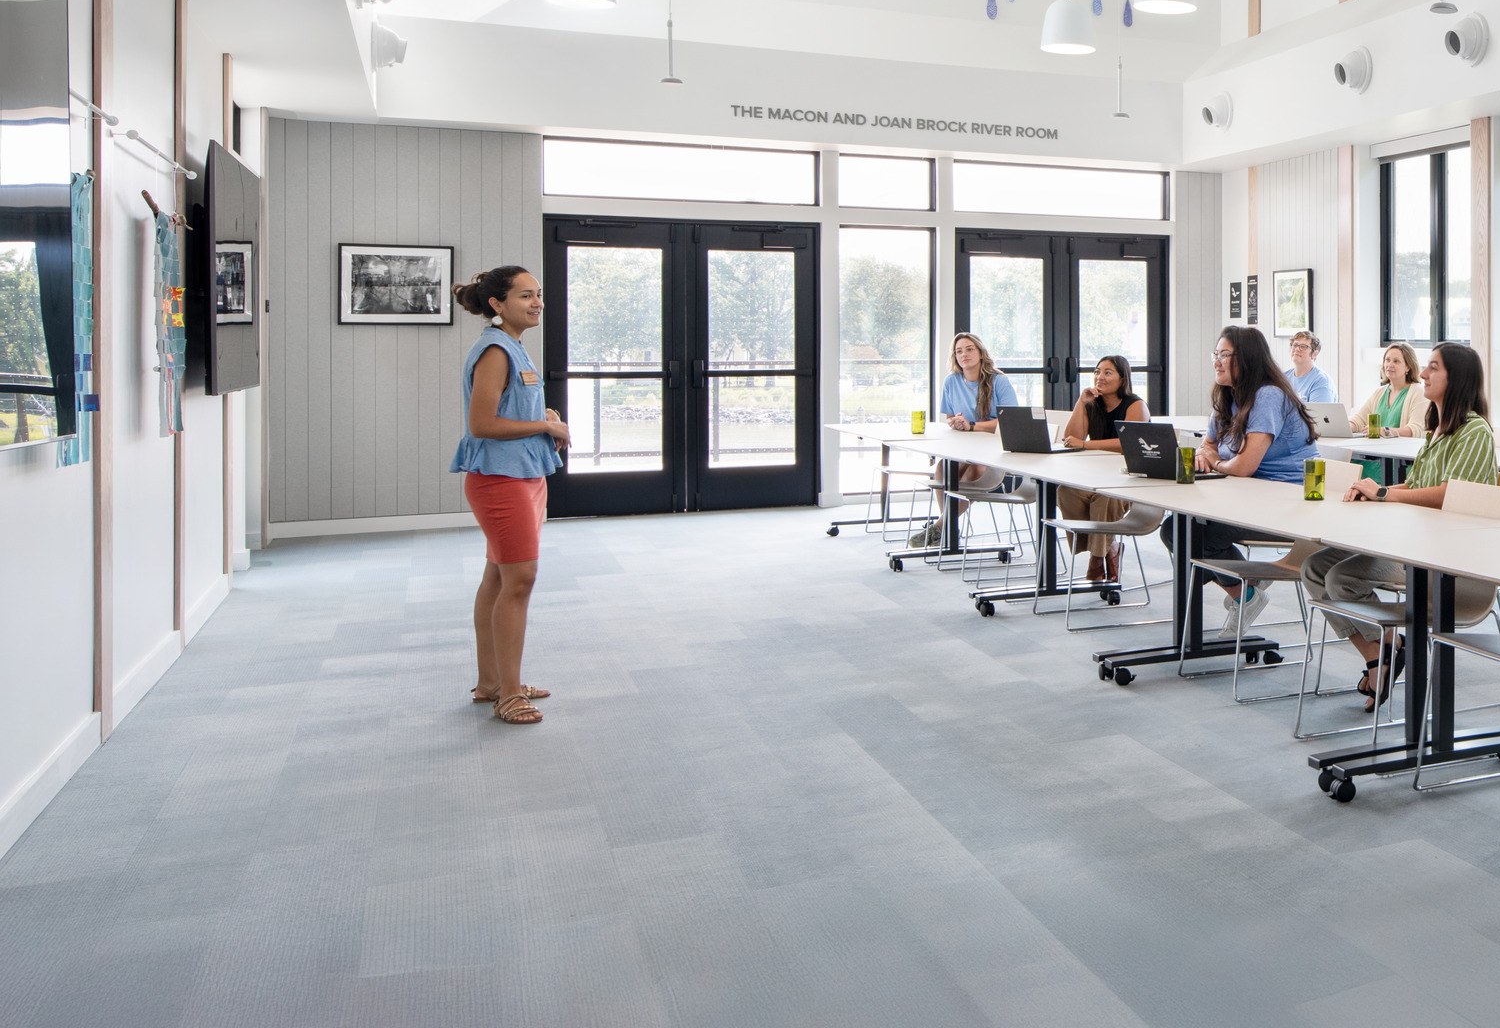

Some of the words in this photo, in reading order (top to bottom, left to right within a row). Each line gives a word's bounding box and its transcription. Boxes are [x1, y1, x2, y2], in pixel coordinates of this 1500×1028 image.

[730, 105, 763, 119] THE
[768, 108, 828, 123] MACON
[832, 113, 867, 126] AND
[871, 115, 912, 129] JOAN
[916, 118, 968, 134] BROCK
[971, 122, 1012, 137] RIVER
[1015, 126, 1059, 140] ROOM
